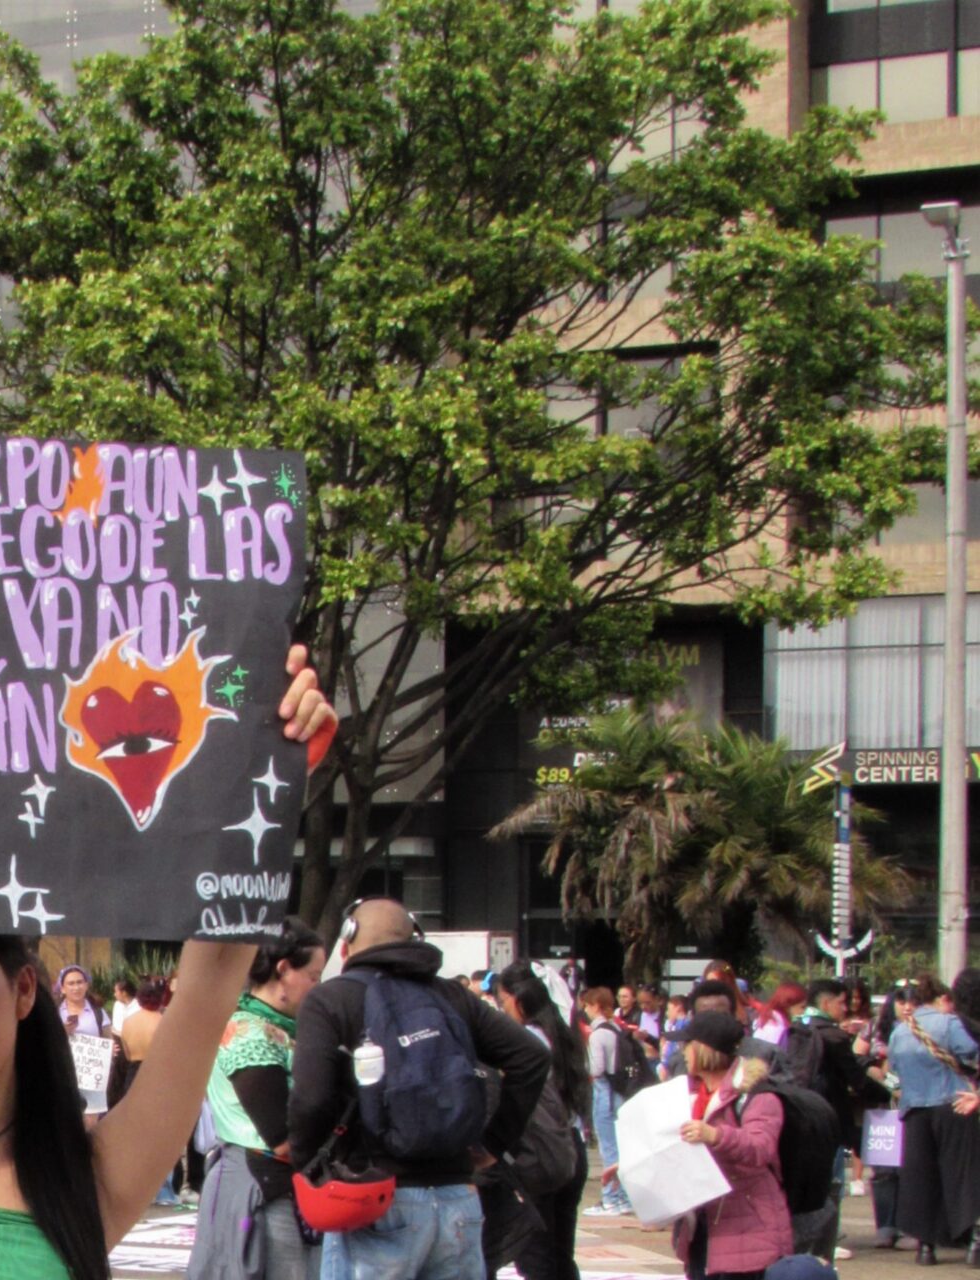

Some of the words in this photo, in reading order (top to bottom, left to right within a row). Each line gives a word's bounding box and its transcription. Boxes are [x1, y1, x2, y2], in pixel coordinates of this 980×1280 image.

[98, 443, 198, 521] AÚN
[100, 514, 169, 584] DE
[189, 504, 293, 585] LAS
[4, 578, 82, 670] YA
[98, 581, 179, 668] NO
[855, 751, 939, 766] SPINNING
[855, 766, 939, 783] CENTER
[869, 1125, 896, 1137] MINI
